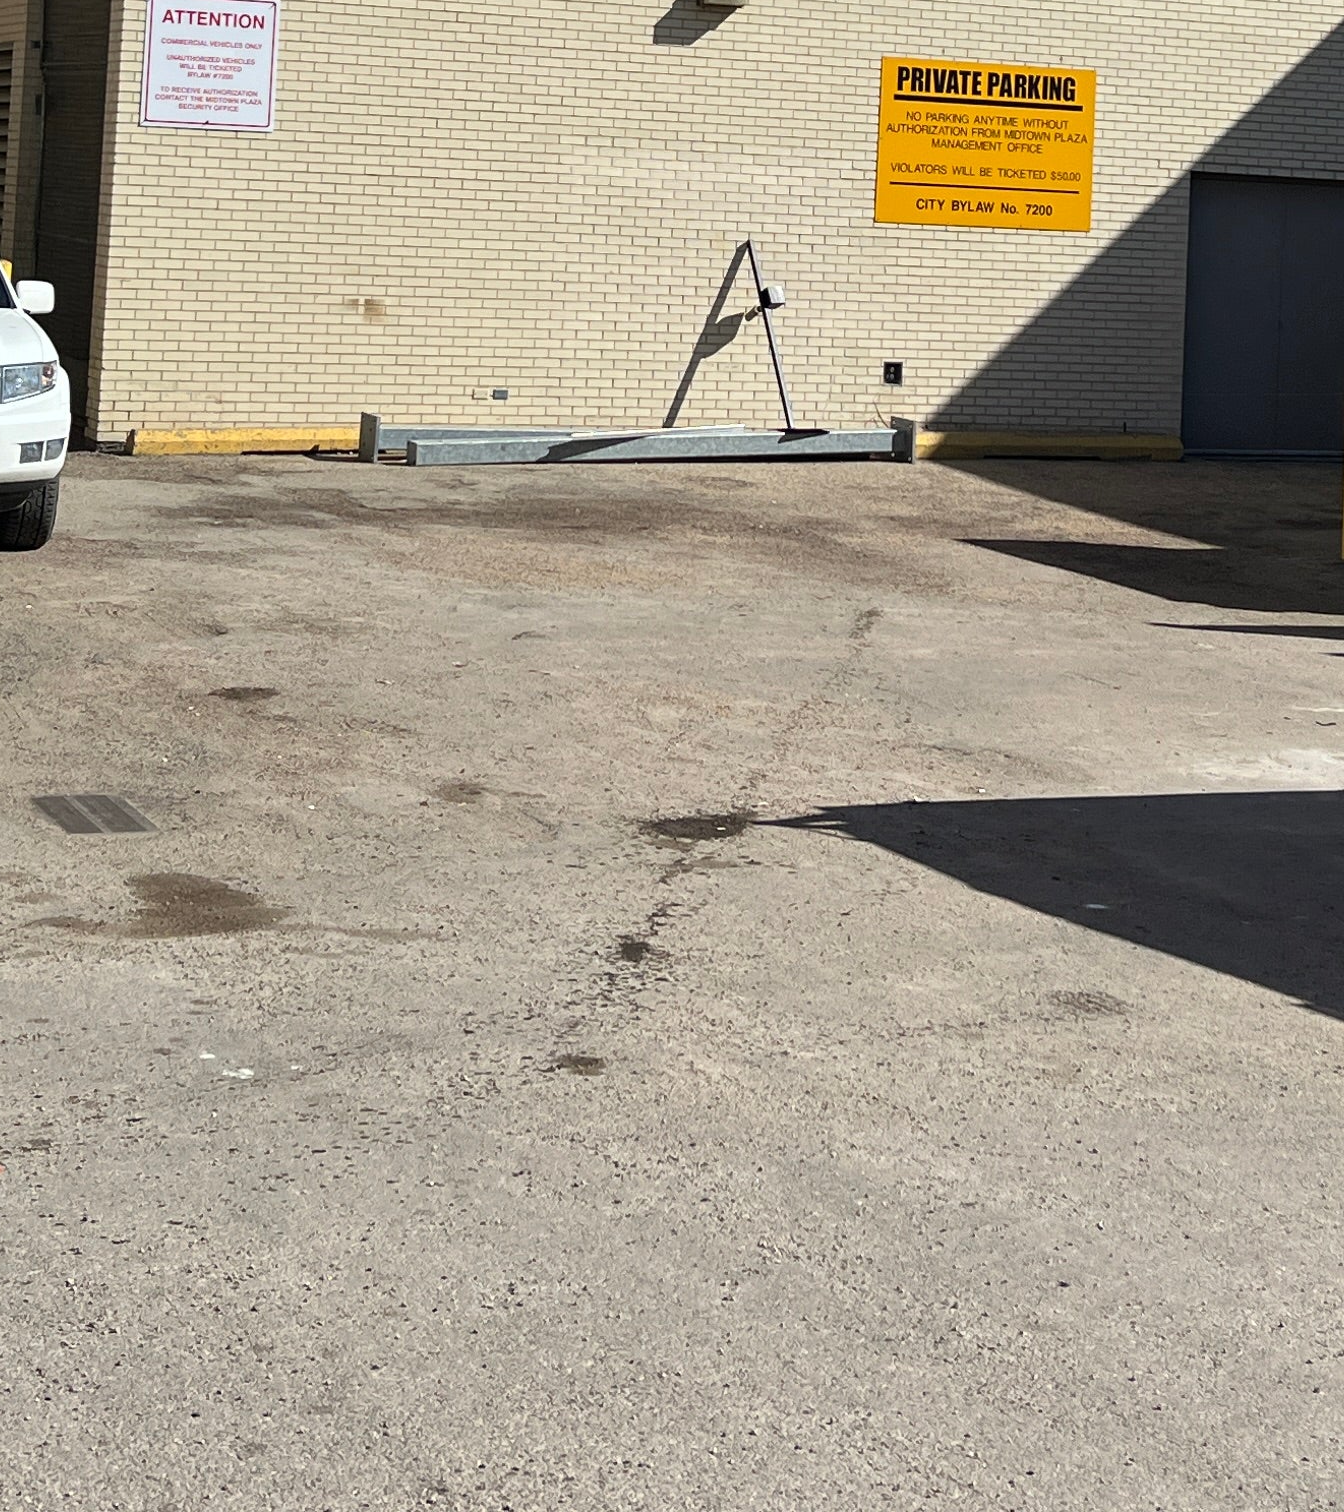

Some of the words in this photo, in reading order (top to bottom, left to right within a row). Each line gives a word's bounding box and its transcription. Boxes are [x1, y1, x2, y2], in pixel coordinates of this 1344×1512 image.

[162, 9, 265, 29] ATTENTION
[161, 38, 207, 47] COMMERCIAL
[210, 41, 243, 49] VEHICLES
[166, 54, 221, 63] UNAUTHORIZED
[223, 57, 255, 65] VEHICLES
[209, 64, 242, 73] TICKETED
[897, 66, 982, 96] PRIVATE
[987, 72, 1076, 102] PARKING
[203, 88, 258, 97] AUTHORIZATION
[205, 96, 239, 104] MIDTOWN
[178, 103, 212, 111] SECURITY
[906, 111, 922, 121] NO
[926, 112, 969, 124] PARKING
[973, 114, 1018, 127] ANYTIME
[1023, 117, 1069, 130] WITHOUT
[886, 123, 968, 136] AUTHORIZATION
[972, 127, 1001, 138] FROM
[1004, 129, 1051, 142] MIDTOWN
[1054, 132, 1088, 144] PLAZA
[931, 138, 1002, 151] MANAGEMENT
[1008, 142, 1043, 154] OFFICE
[891, 162, 948, 174] VIOLATORS
[952, 166, 975, 177] WILL
[980, 167, 992, 177] BE
[997, 168, 1047, 180] TICKETED
[1050, 171, 1081, 182] $50.00
[916, 198, 945, 211] CITY
[951, 199, 995, 213] BYLAW
[1000, 202, 1020, 214] No.
[1025, 204, 1053, 216] 7200
